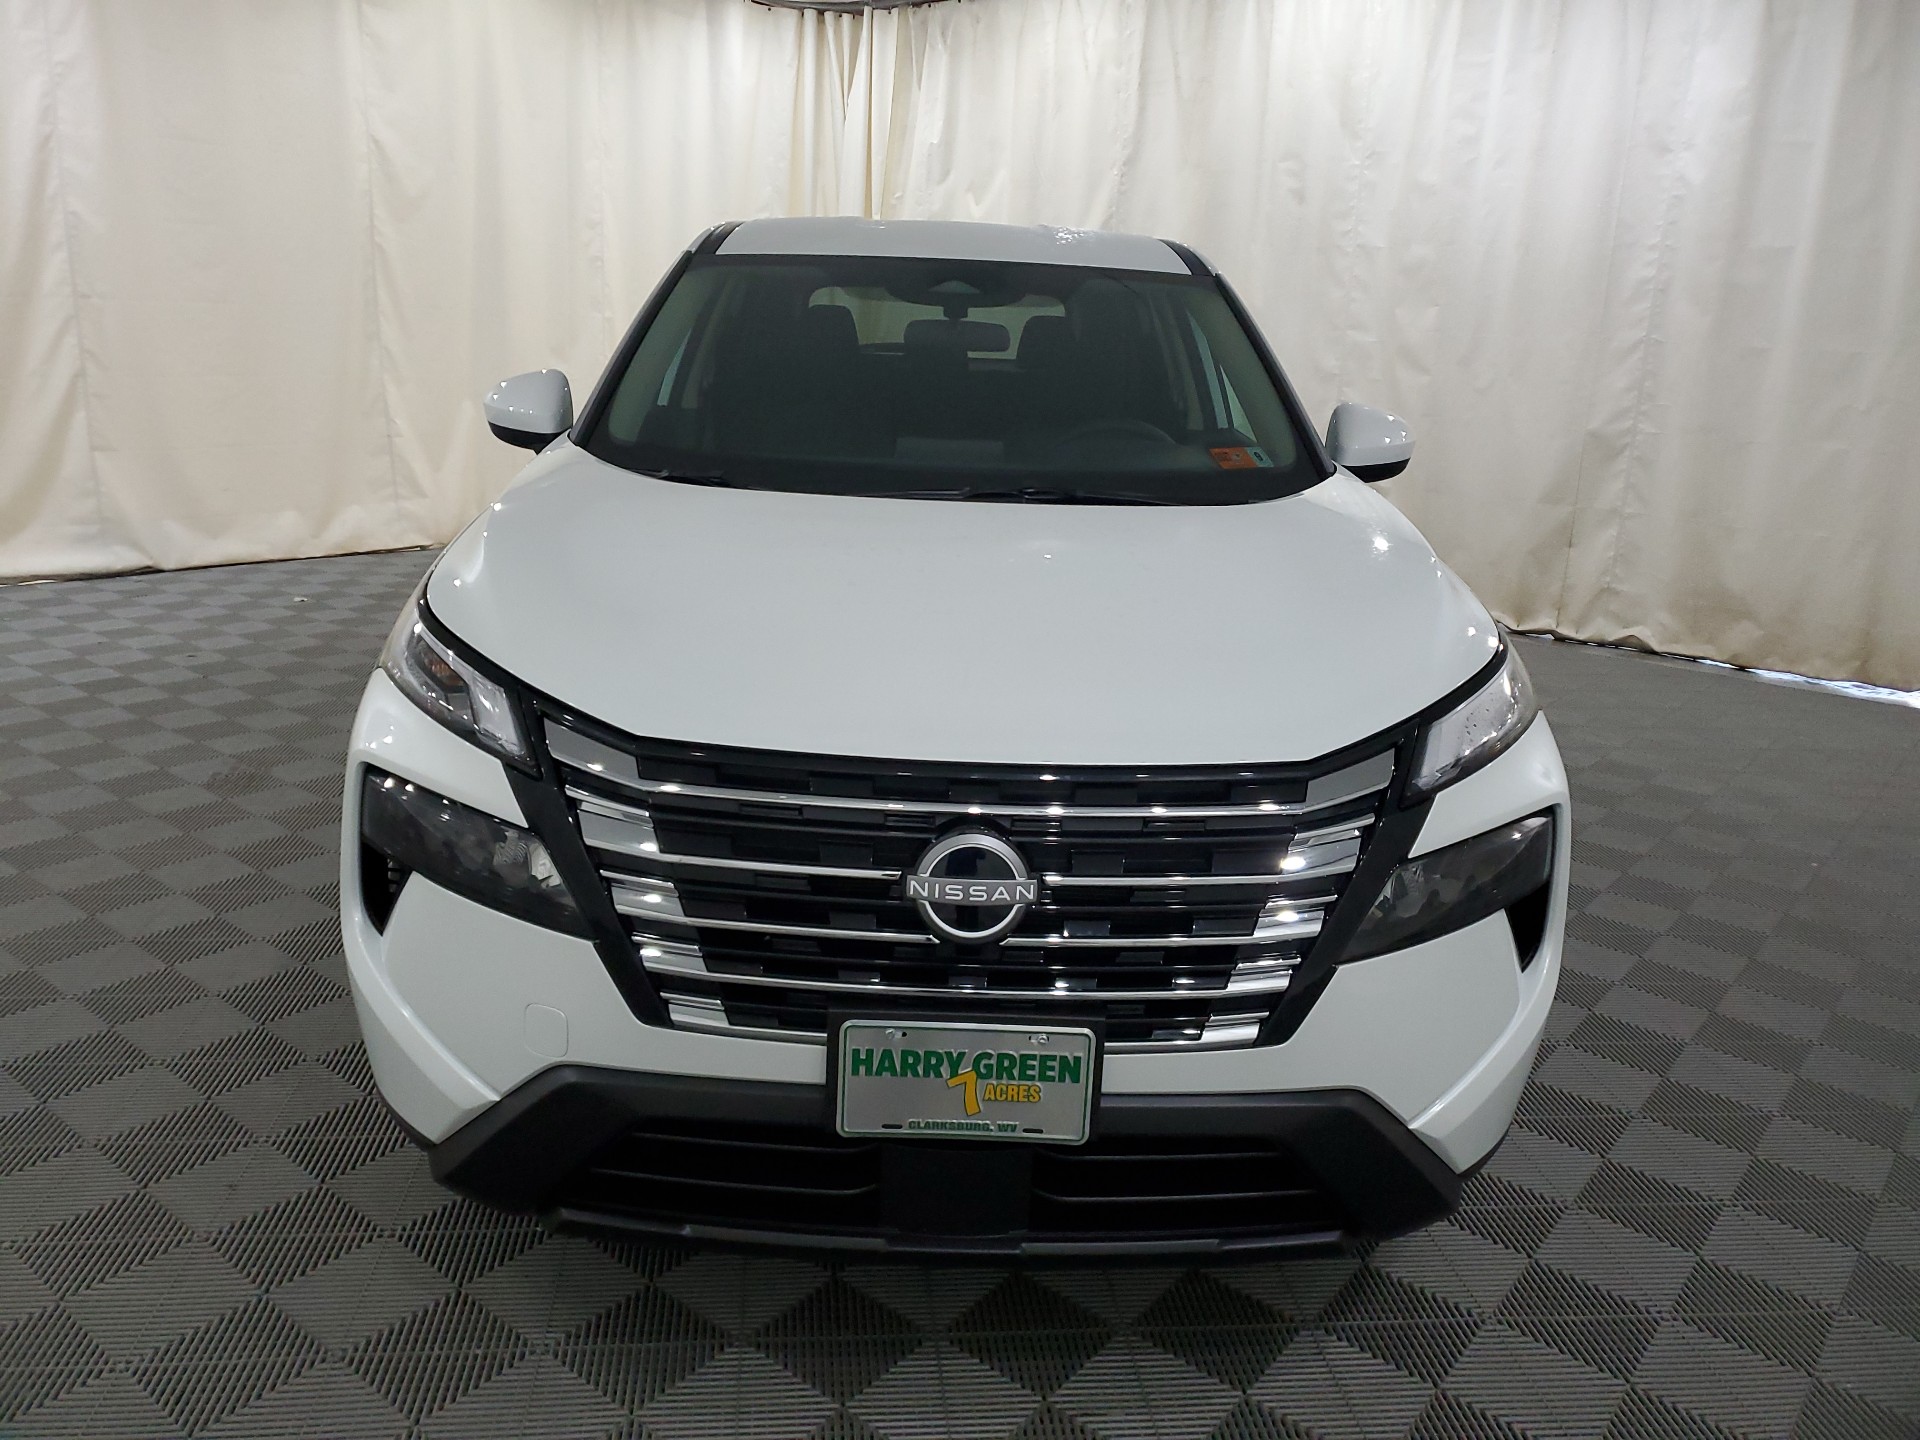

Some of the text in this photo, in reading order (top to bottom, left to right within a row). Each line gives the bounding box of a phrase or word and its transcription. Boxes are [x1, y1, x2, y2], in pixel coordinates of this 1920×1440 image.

[909, 880, 1034, 901] NISSAN
[851, 1048, 1082, 1083] HARRY GREEN
[946, 1071, 1041, 1116] 7 ACRES
[997, 1122, 1019, 1133] WV
